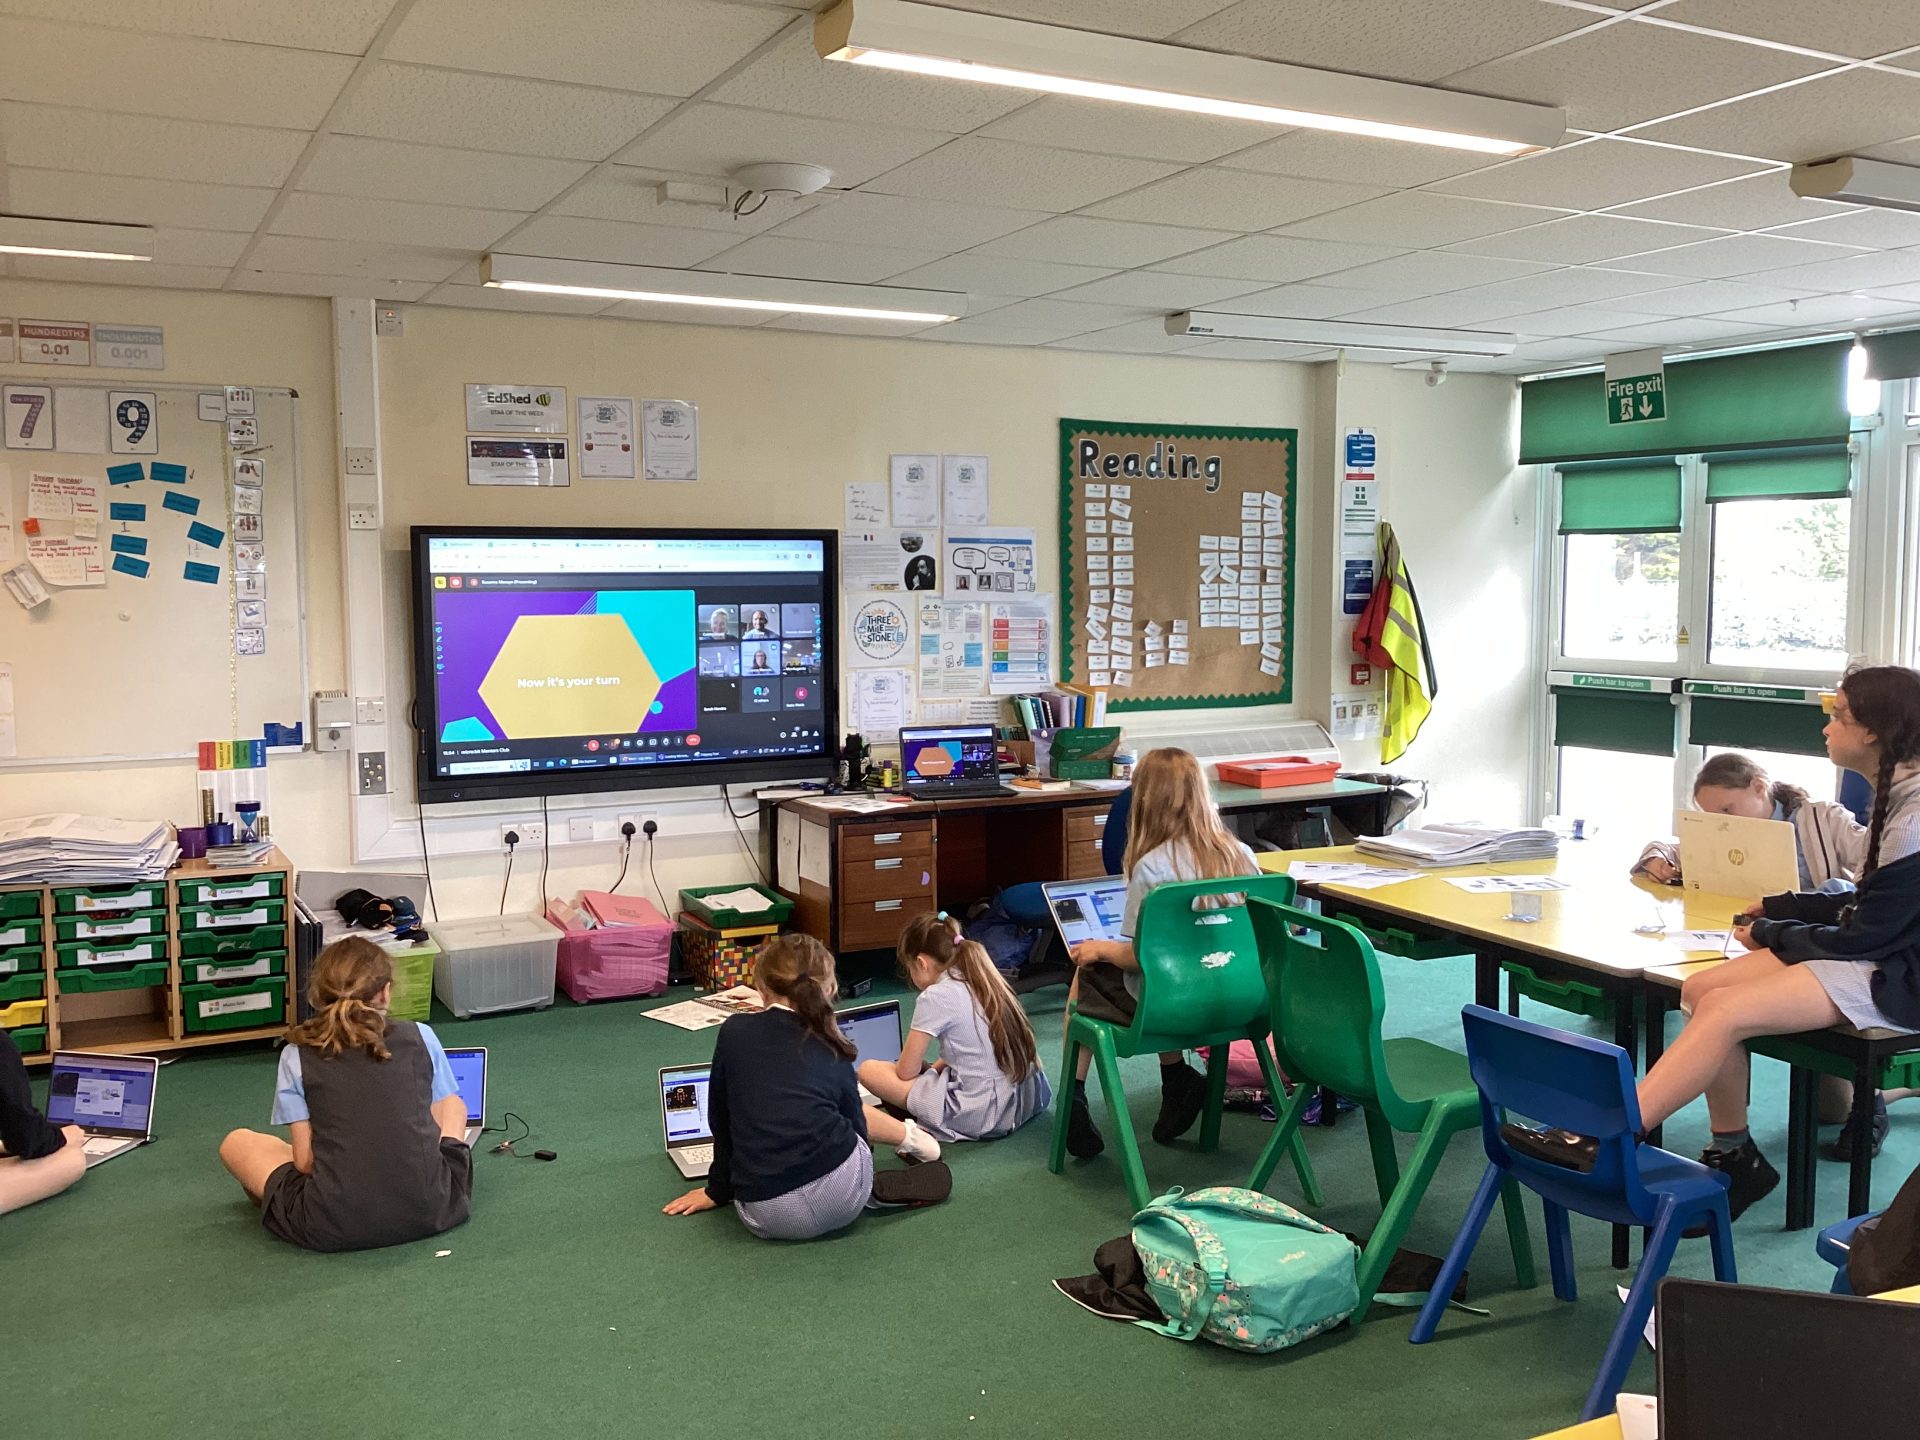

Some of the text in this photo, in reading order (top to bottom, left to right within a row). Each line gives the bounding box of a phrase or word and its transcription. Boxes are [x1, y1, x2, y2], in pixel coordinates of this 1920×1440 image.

[23, 326, 86, 338] HUNDREDTHS
[41, 343, 70, 355] 0.01
[111, 347, 149, 359] 0.001
[1607, 376, 1662, 398] Fire exit
[487, 391, 531, 404] EdShed
[10, 394, 45, 438] 7
[116, 400, 150, 444] 9
[1079, 439, 1221, 493] Reading
[866, 615, 891, 625] THREE
[867, 632, 892, 643] STONE
[517, 676, 621, 688] Now it's your turn
[1588, 676, 1605, 685] Push
[1605, 678, 1617, 686] bar
[1626, 681, 1644, 689] open
[1713, 685, 1732, 693] Push
[1733, 686, 1746, 694] bar
[1757, 689, 1777, 697] open
[1728, 849, 1744, 866] hp
